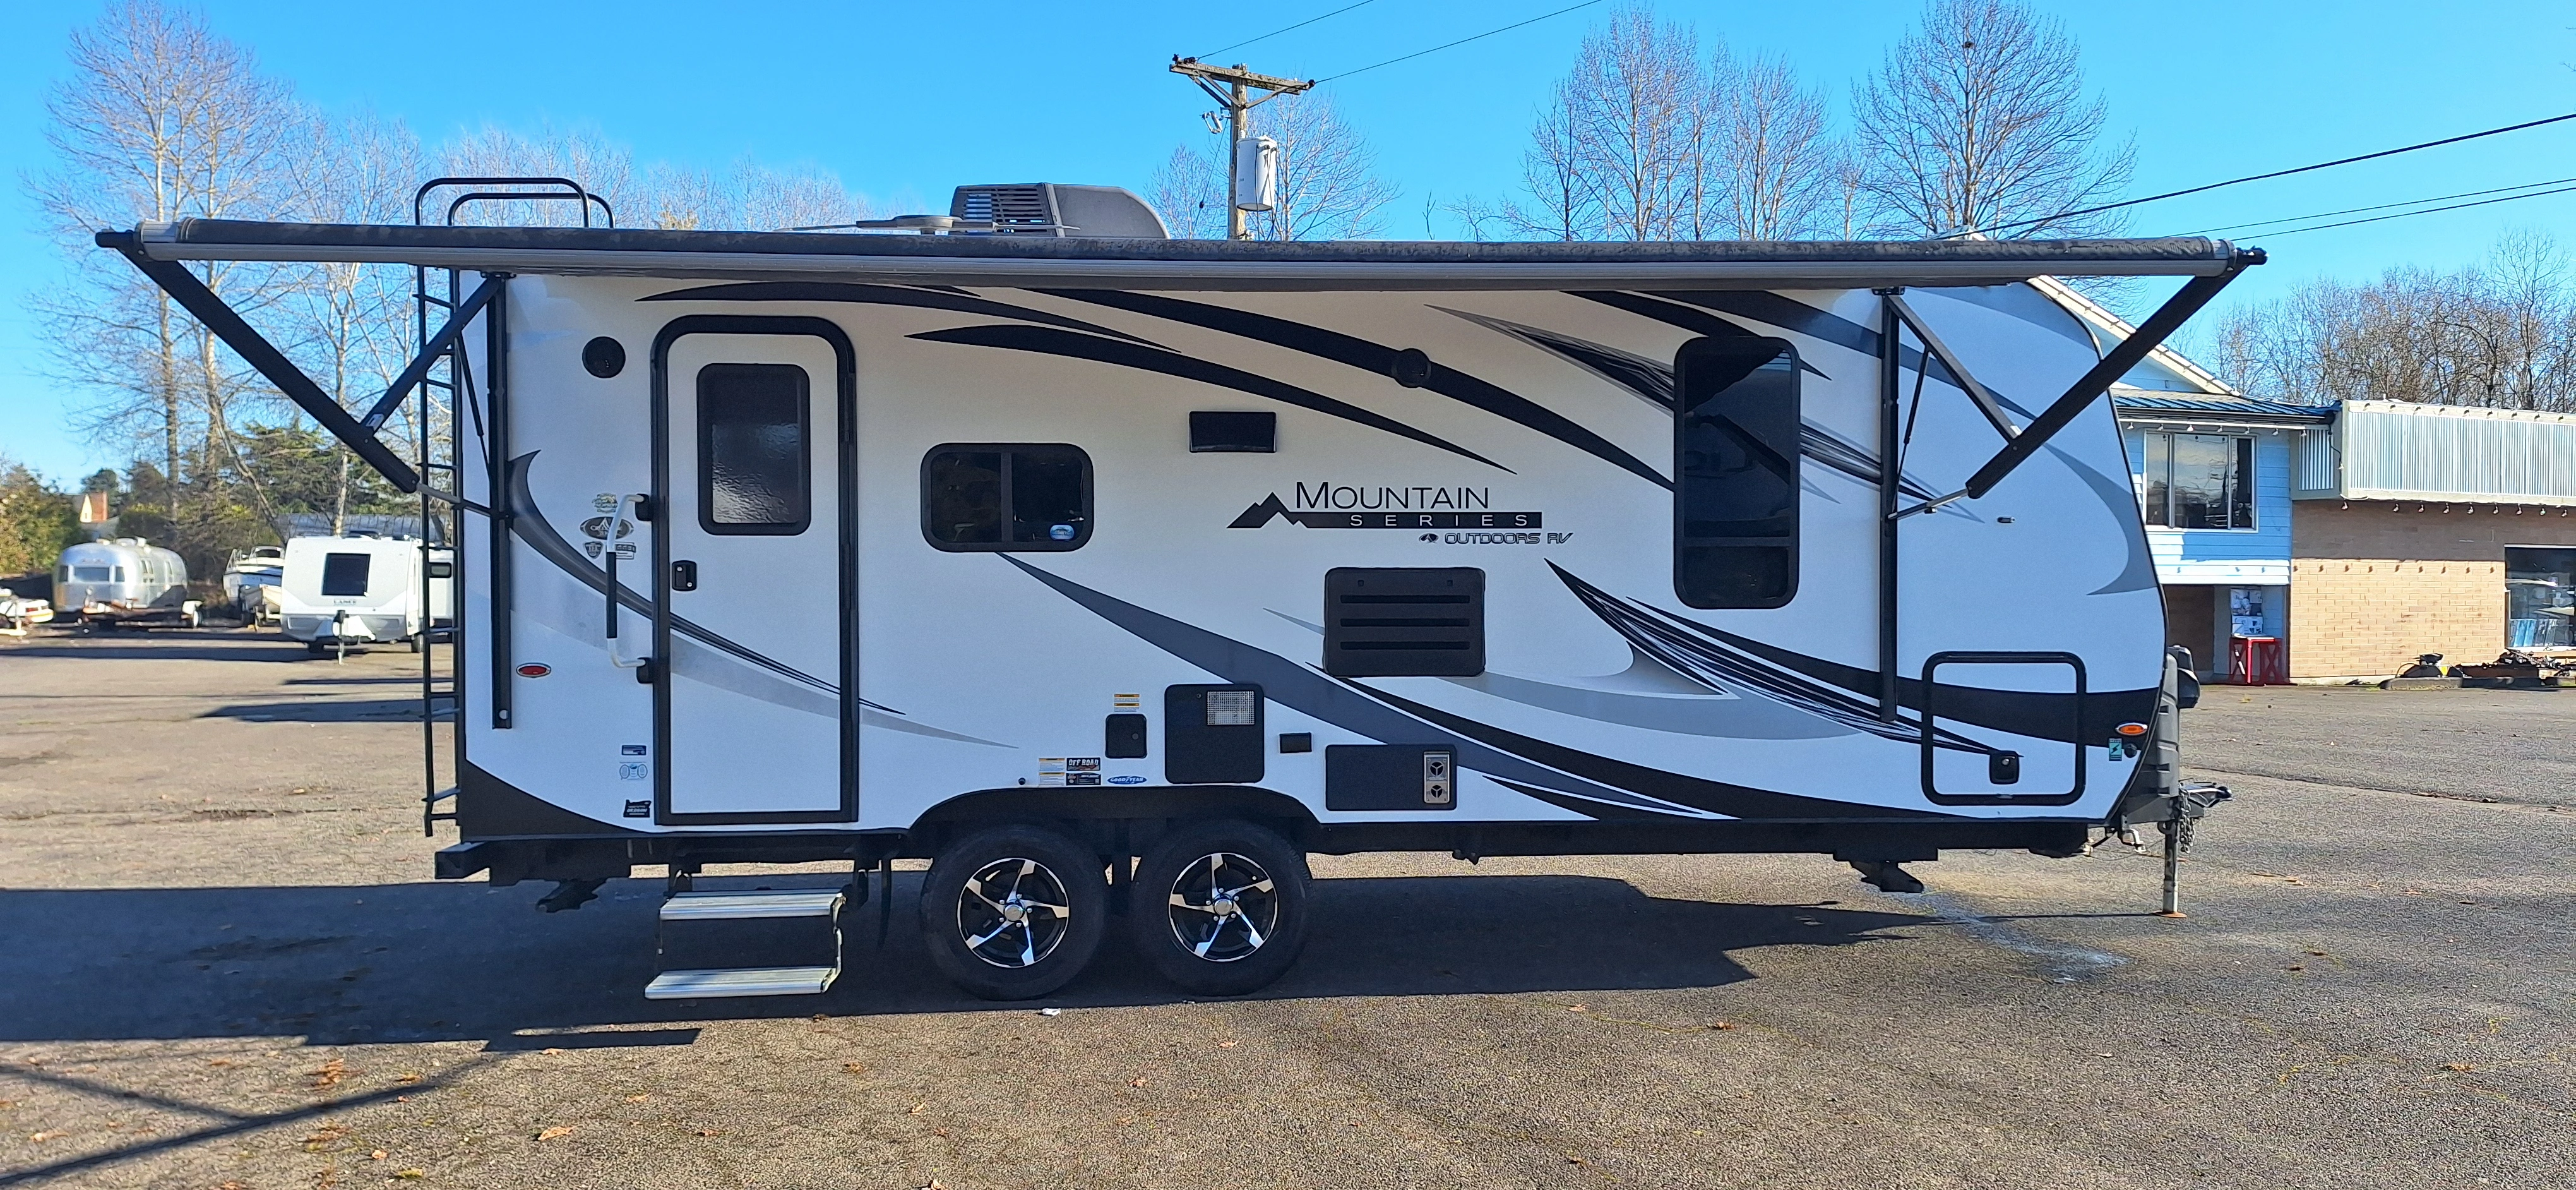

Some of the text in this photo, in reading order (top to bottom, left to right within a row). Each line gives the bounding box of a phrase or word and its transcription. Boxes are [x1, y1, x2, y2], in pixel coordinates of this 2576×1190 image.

[1349, 514, 1528, 527] SERIES
[1445, 532, 1574, 544] OUTDOORS RV
